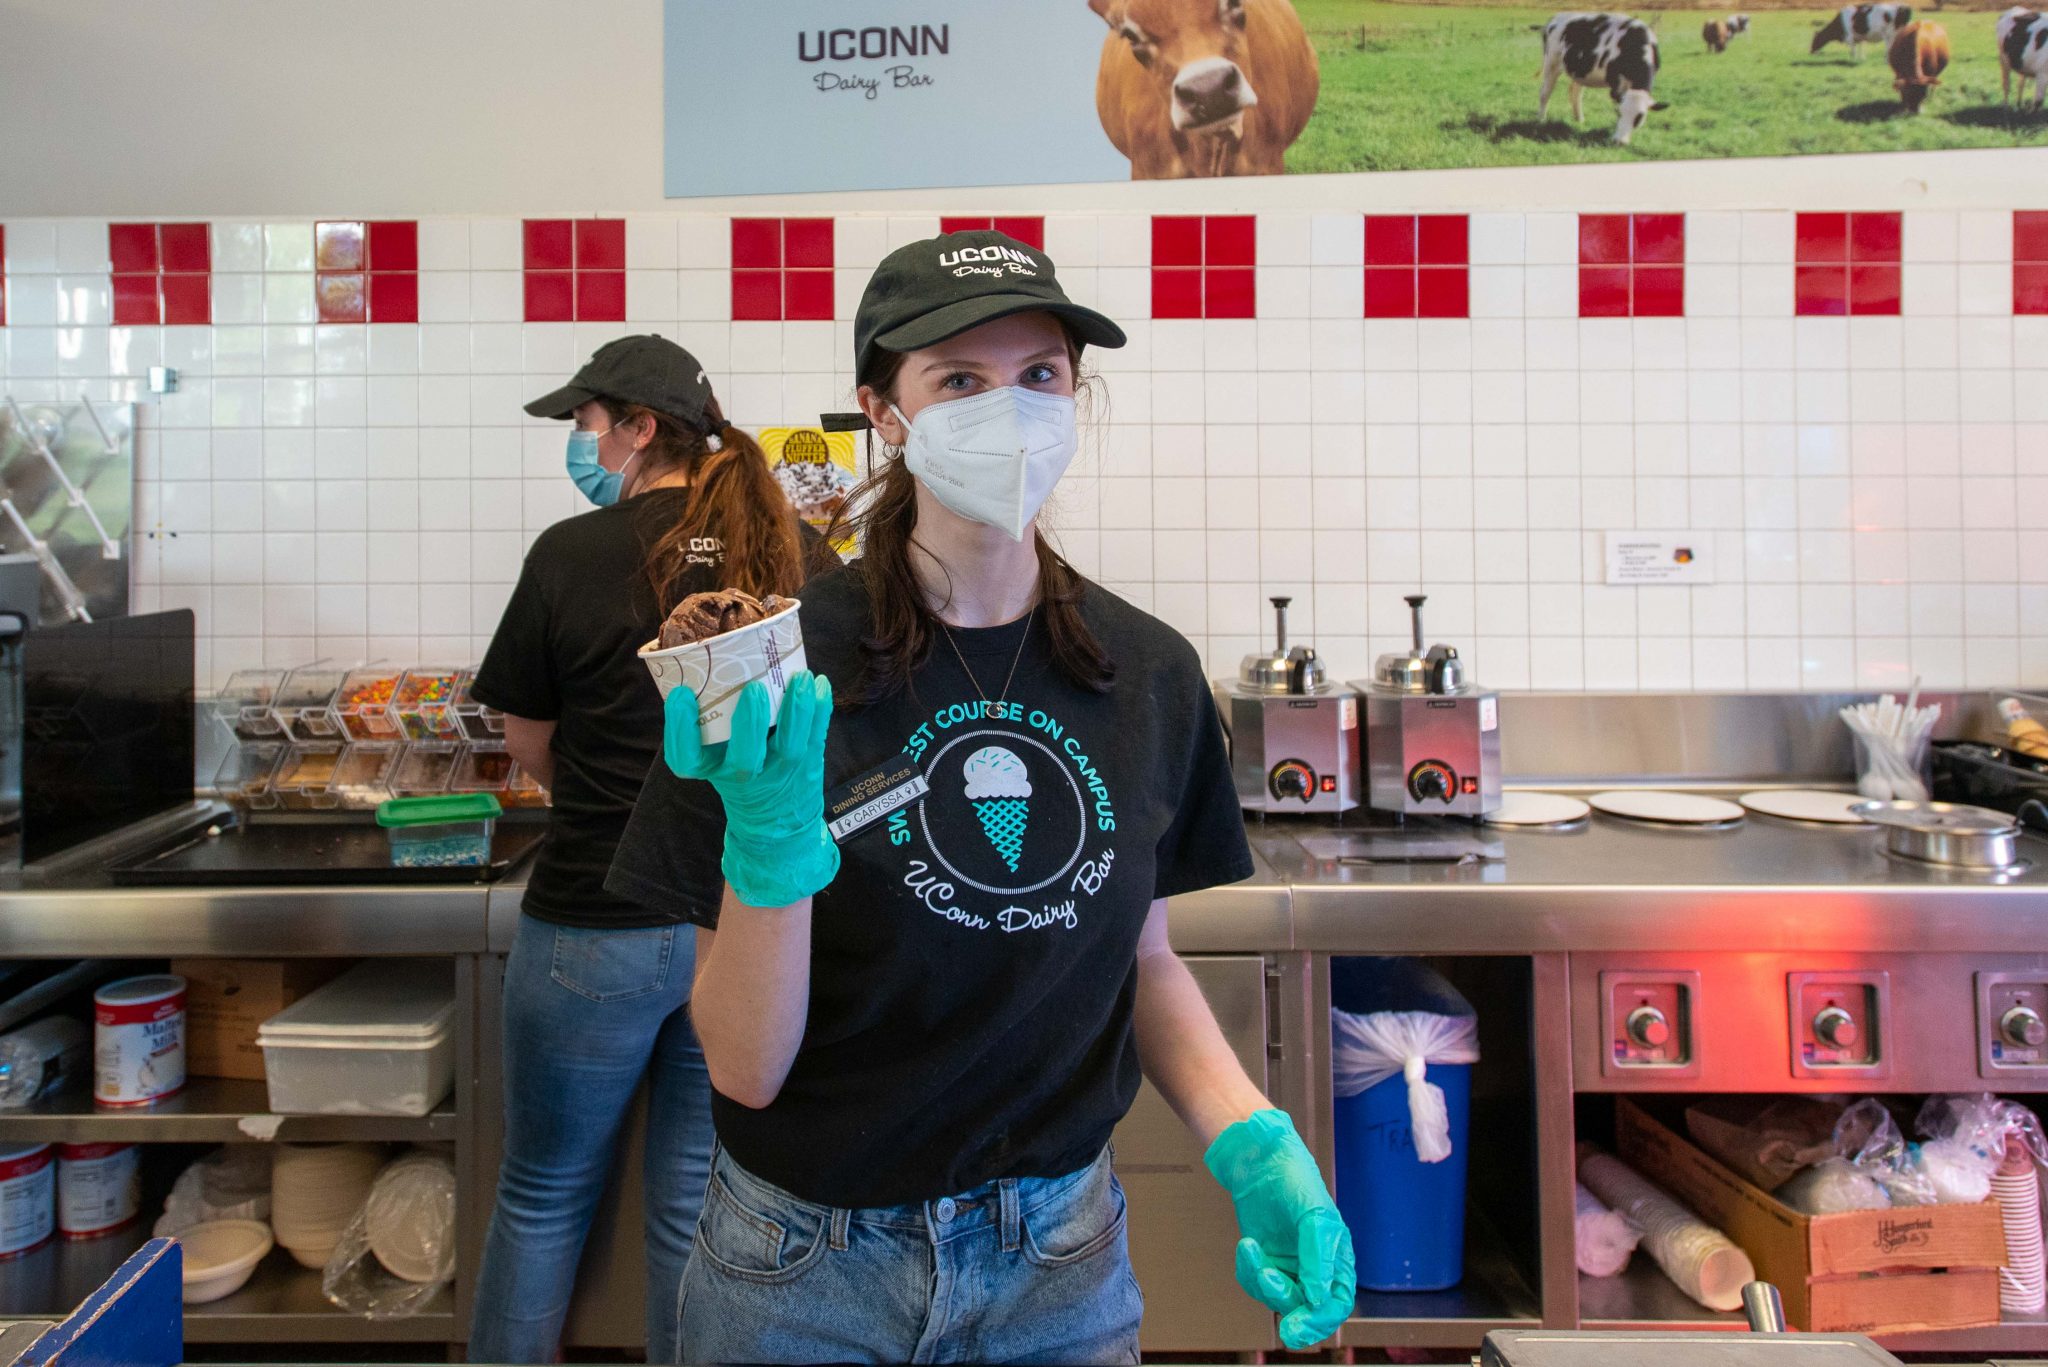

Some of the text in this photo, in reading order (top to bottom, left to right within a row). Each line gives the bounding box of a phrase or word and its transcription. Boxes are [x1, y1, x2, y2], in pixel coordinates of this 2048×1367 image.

[798, 24, 949, 62] UCONN
[813, 65, 934, 99] Dairy Bar
[940, 246, 1038, 267] UCONN
[953, 262, 1036, 278] Dairy Bar
[678, 537, 726, 552] CON
[851, 772, 885, 794] UCONN
[1029, 710, 1064, 741] ON
[1063, 738, 1116, 831] CAMPUS
[832, 768, 911, 814] DINING SERVICES
[853, 791, 904, 823] CARYSSA
[904, 848, 1115, 933] UConn Dairy Bar
